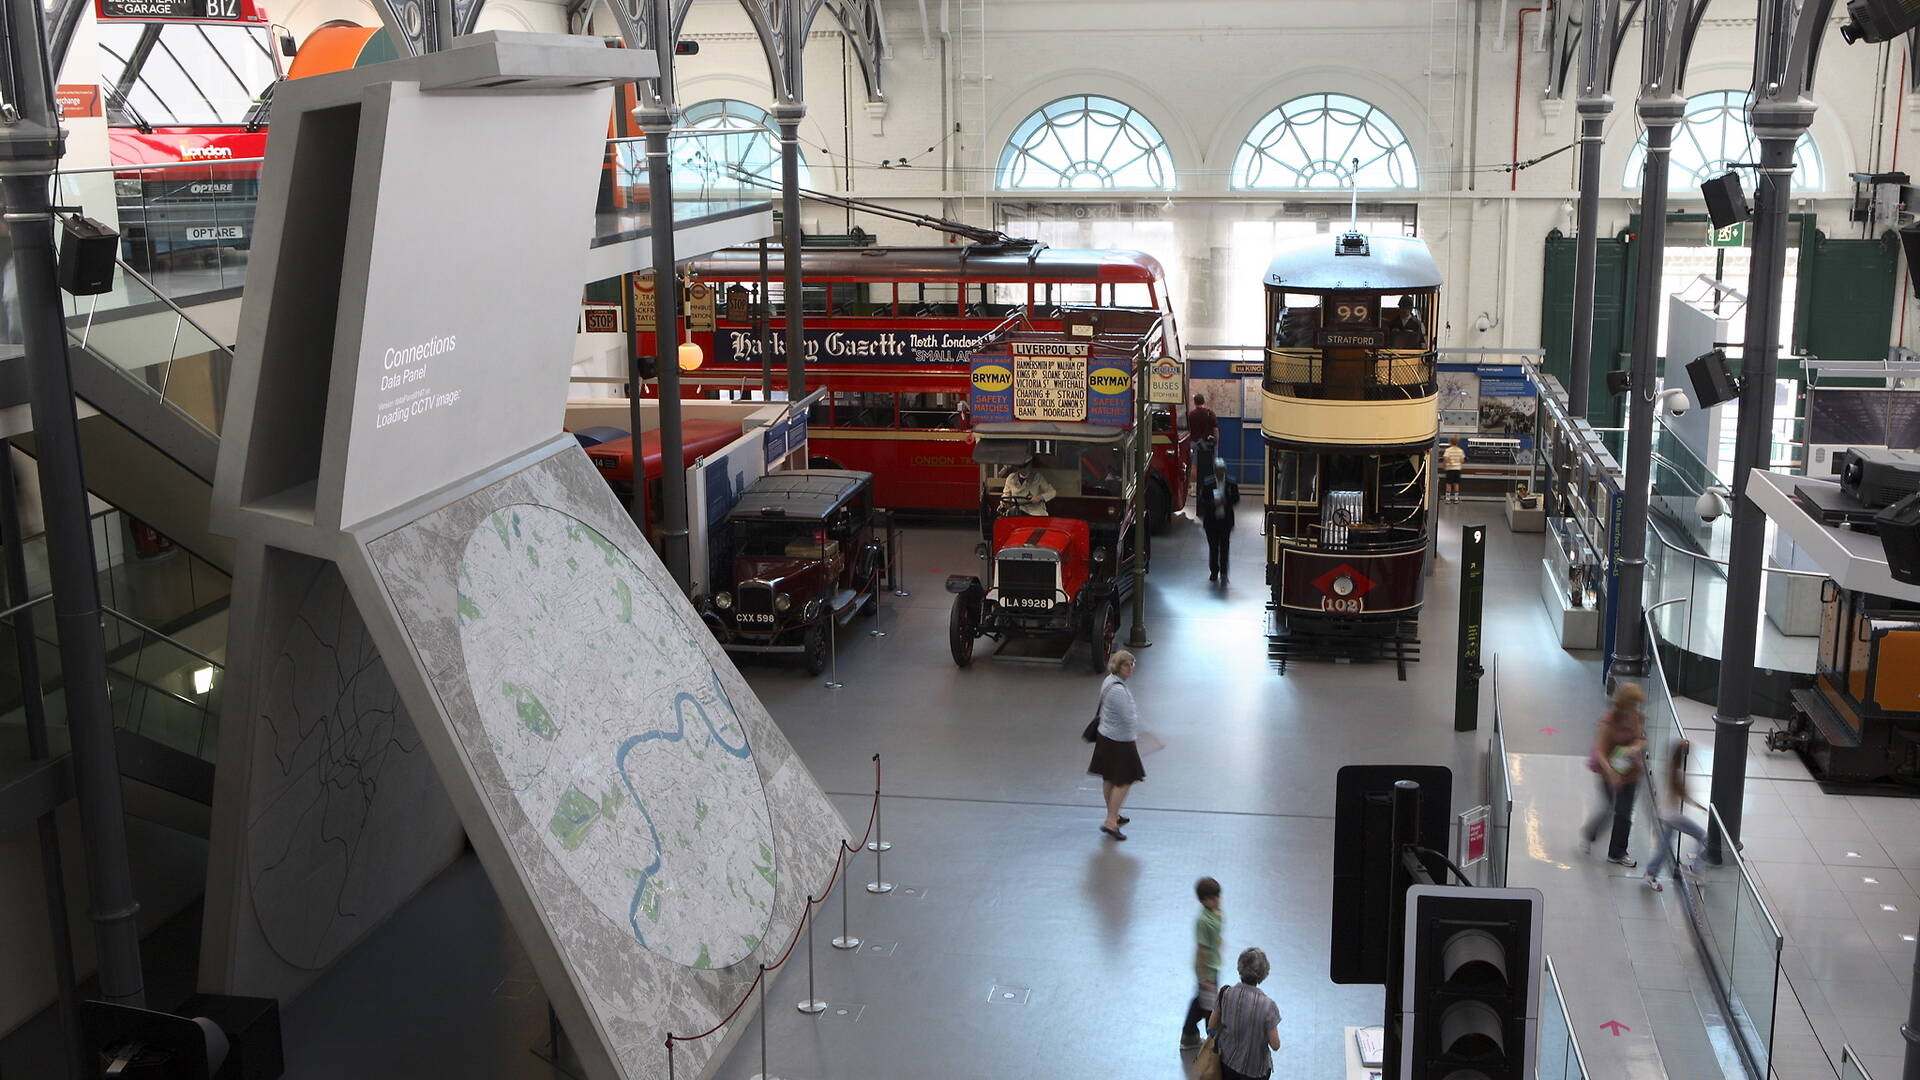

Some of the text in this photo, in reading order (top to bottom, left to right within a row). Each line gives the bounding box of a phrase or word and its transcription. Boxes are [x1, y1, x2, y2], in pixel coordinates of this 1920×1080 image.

[124, 4, 171, 14] GARAGE
[180, 145, 232, 156] London
[191, 183, 233, 194] OPTARE
[192, 228, 236, 239] OPTARE
[730, 299, 747, 310] STOP
[1337, 305, 1368, 322] 99
[589, 315, 613, 328] STOP
[910, 334, 938, 348] North
[1327, 335, 1375, 346] STRATFORD
[730, 331, 906, 362] Haky Gazette
[1016, 344, 1071, 355] LIVERPOOL
[383, 335, 457, 371] Connections
[1016, 361, 1048, 370] HAMMERSMITH
[381, 363, 427, 392] Data Panel
[972, 373, 1011, 384] BRYMAY
[1016, 370, 1031, 379] KINGS
[1042, 370, 1061, 380] SLOANE
[1062, 370, 1085, 380] SQUARE
[1016, 379, 1042, 388] VICTORIA
[1054, 380, 1085, 389] WHITEHALL
[1089, 376, 1130, 387] BRYMAY
[1152, 381, 1180, 391] BUSES
[975, 395, 1009, 404] SAFETY
[1016, 388, 1085, 400] CHARING STRAND
[974, 404, 1009, 413] MATCHES
[1016, 398, 1037, 407] LUDGATE
[1037, 399, 1056, 408] CIRCUS
[1057, 400, 1079, 409] CANNON
[376, 407, 410, 429] Loading
[411, 394, 436, 416] CCTV
[1018, 408, 1037, 417] BANK
[1043, 408, 1075, 417] MOORGATE
[1034, 440, 1051, 454] 11
[911, 455, 955, 465] LONDON
[1474, 530, 1482, 543] 9
[1006, 598, 1047, 608] LA 9928
[736, 613, 775, 623] CXX 598
